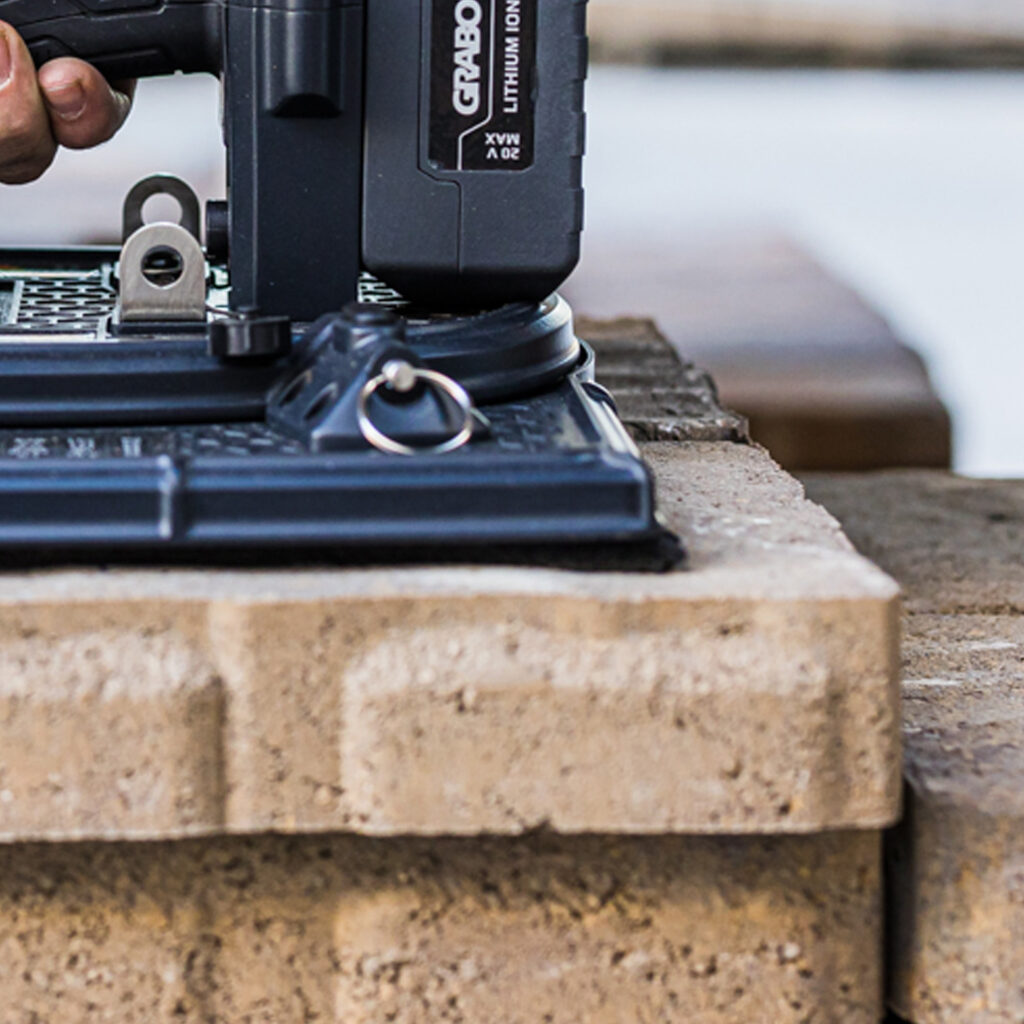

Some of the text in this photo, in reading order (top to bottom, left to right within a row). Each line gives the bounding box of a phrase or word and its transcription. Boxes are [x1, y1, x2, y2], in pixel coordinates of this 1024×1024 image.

[503, 37, 521, 114] LITHIUM
[484, 133, 521, 145] MAX
[486, 147, 521, 160] 20 V
